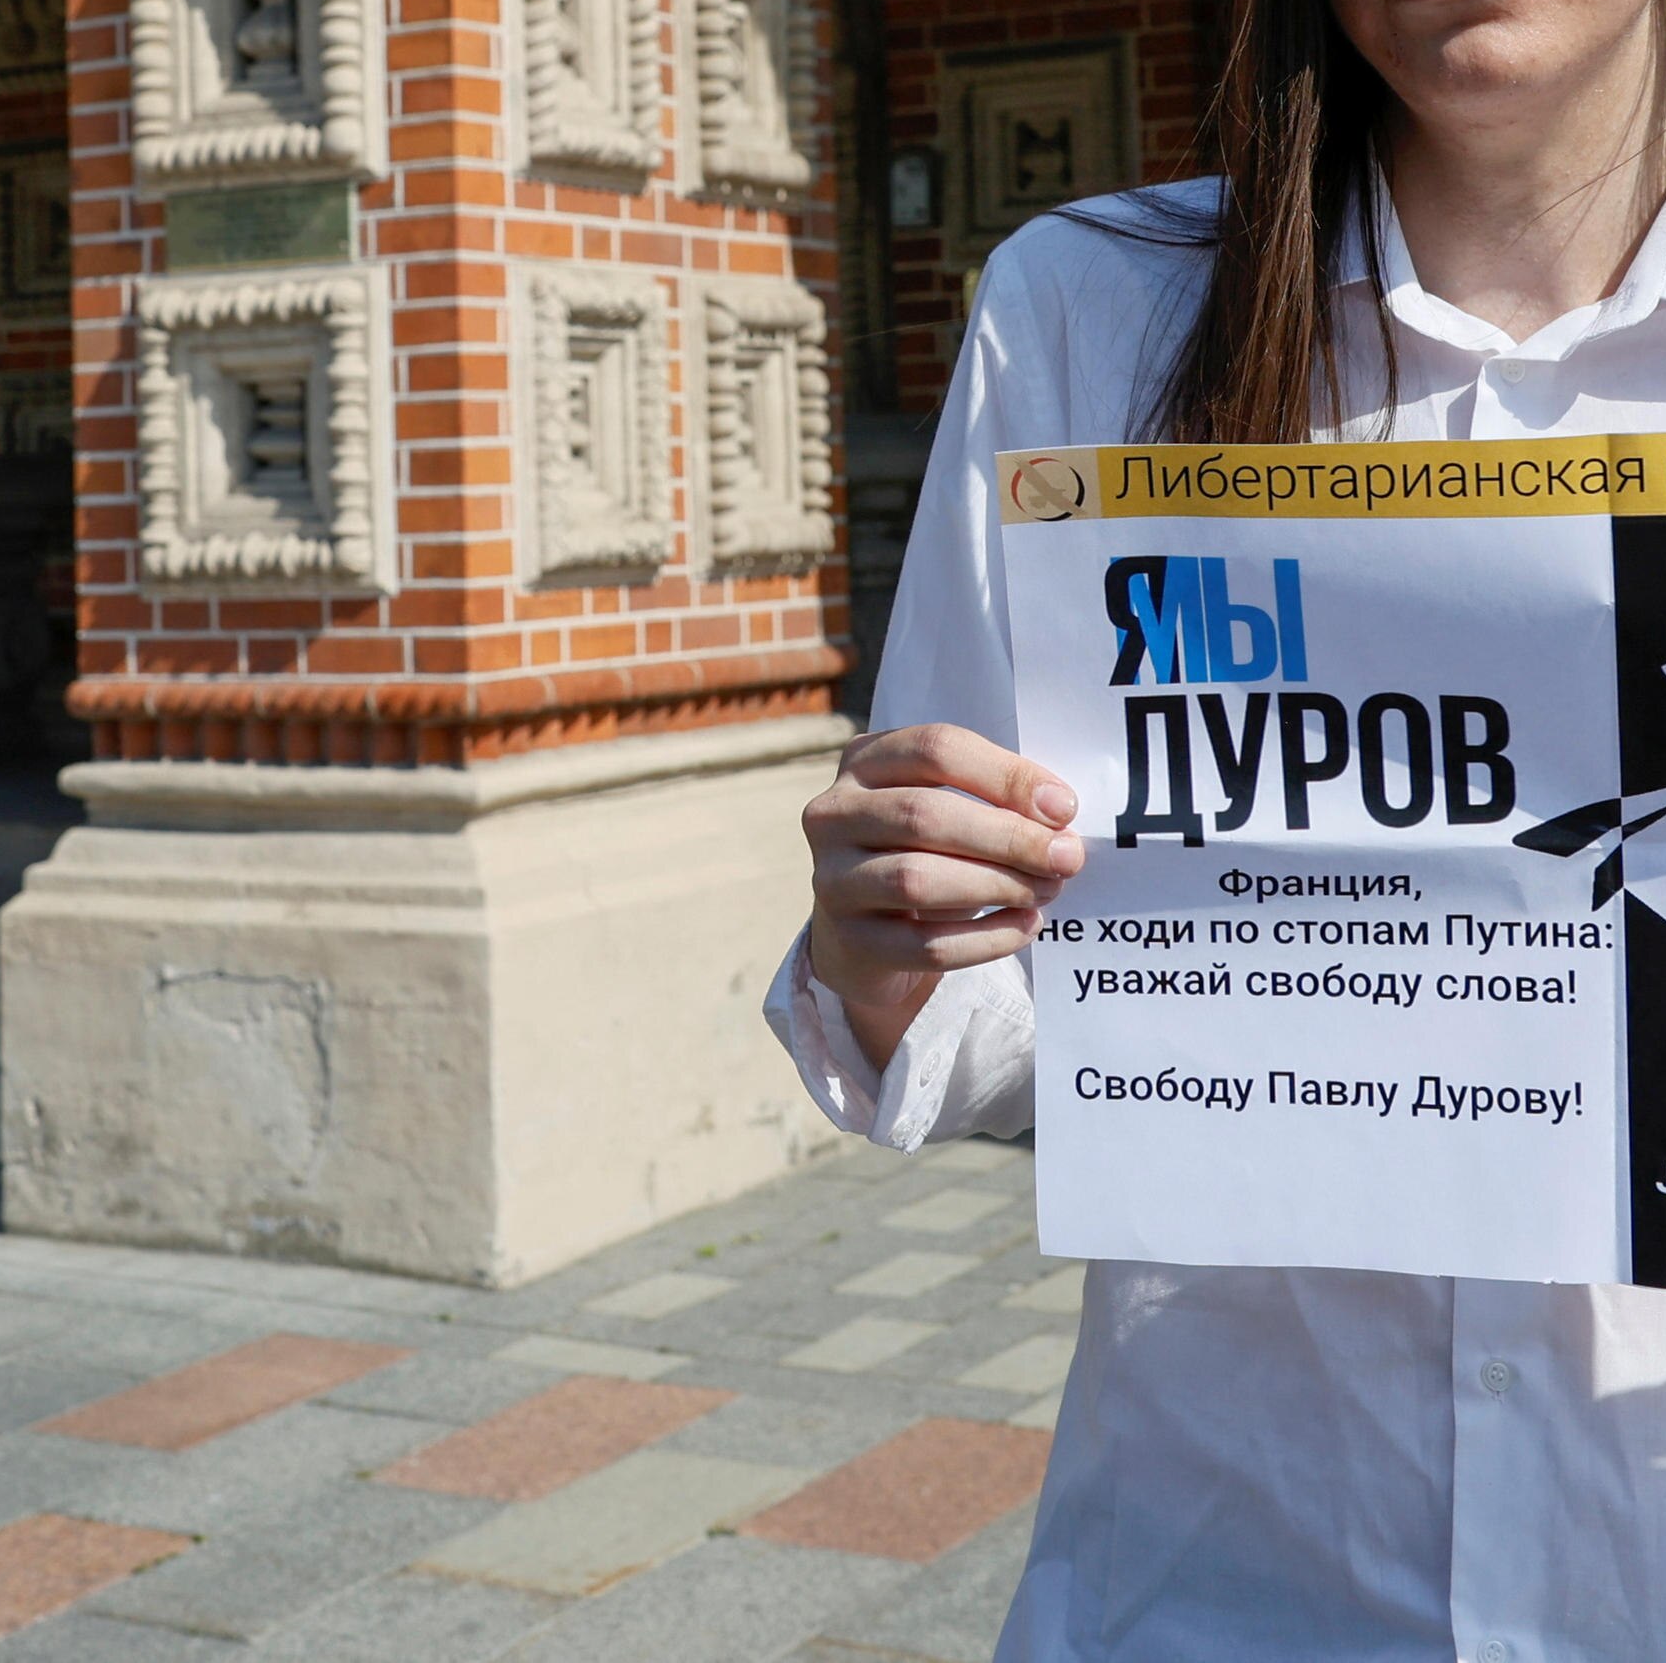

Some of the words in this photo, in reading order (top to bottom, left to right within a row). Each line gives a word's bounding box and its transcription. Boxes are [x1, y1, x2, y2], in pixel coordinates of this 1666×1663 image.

[1115, 453, 1645, 512] Либертарианская
[1115, 691, 1516, 849] ДУРОВ
[1218, 867, 1423, 904] Франция,
[1037, 918, 1084, 945] не
[1097, 918, 1195, 950] ходи
[1209, 919, 1260, 945] по
[1272, 920, 1430, 946] стопам
[1445, 915, 1614, 956] Путина:
[1073, 961, 1232, 1002] уважай
[1246, 964, 1422, 1007] свободу
[1436, 969, 1577, 1004] слова!
[1074, 1068, 1254, 1111] Свободу
[1267, 1071, 1397, 1116] Павлу
[1411, 1075, 1584, 1123] Дурову!
